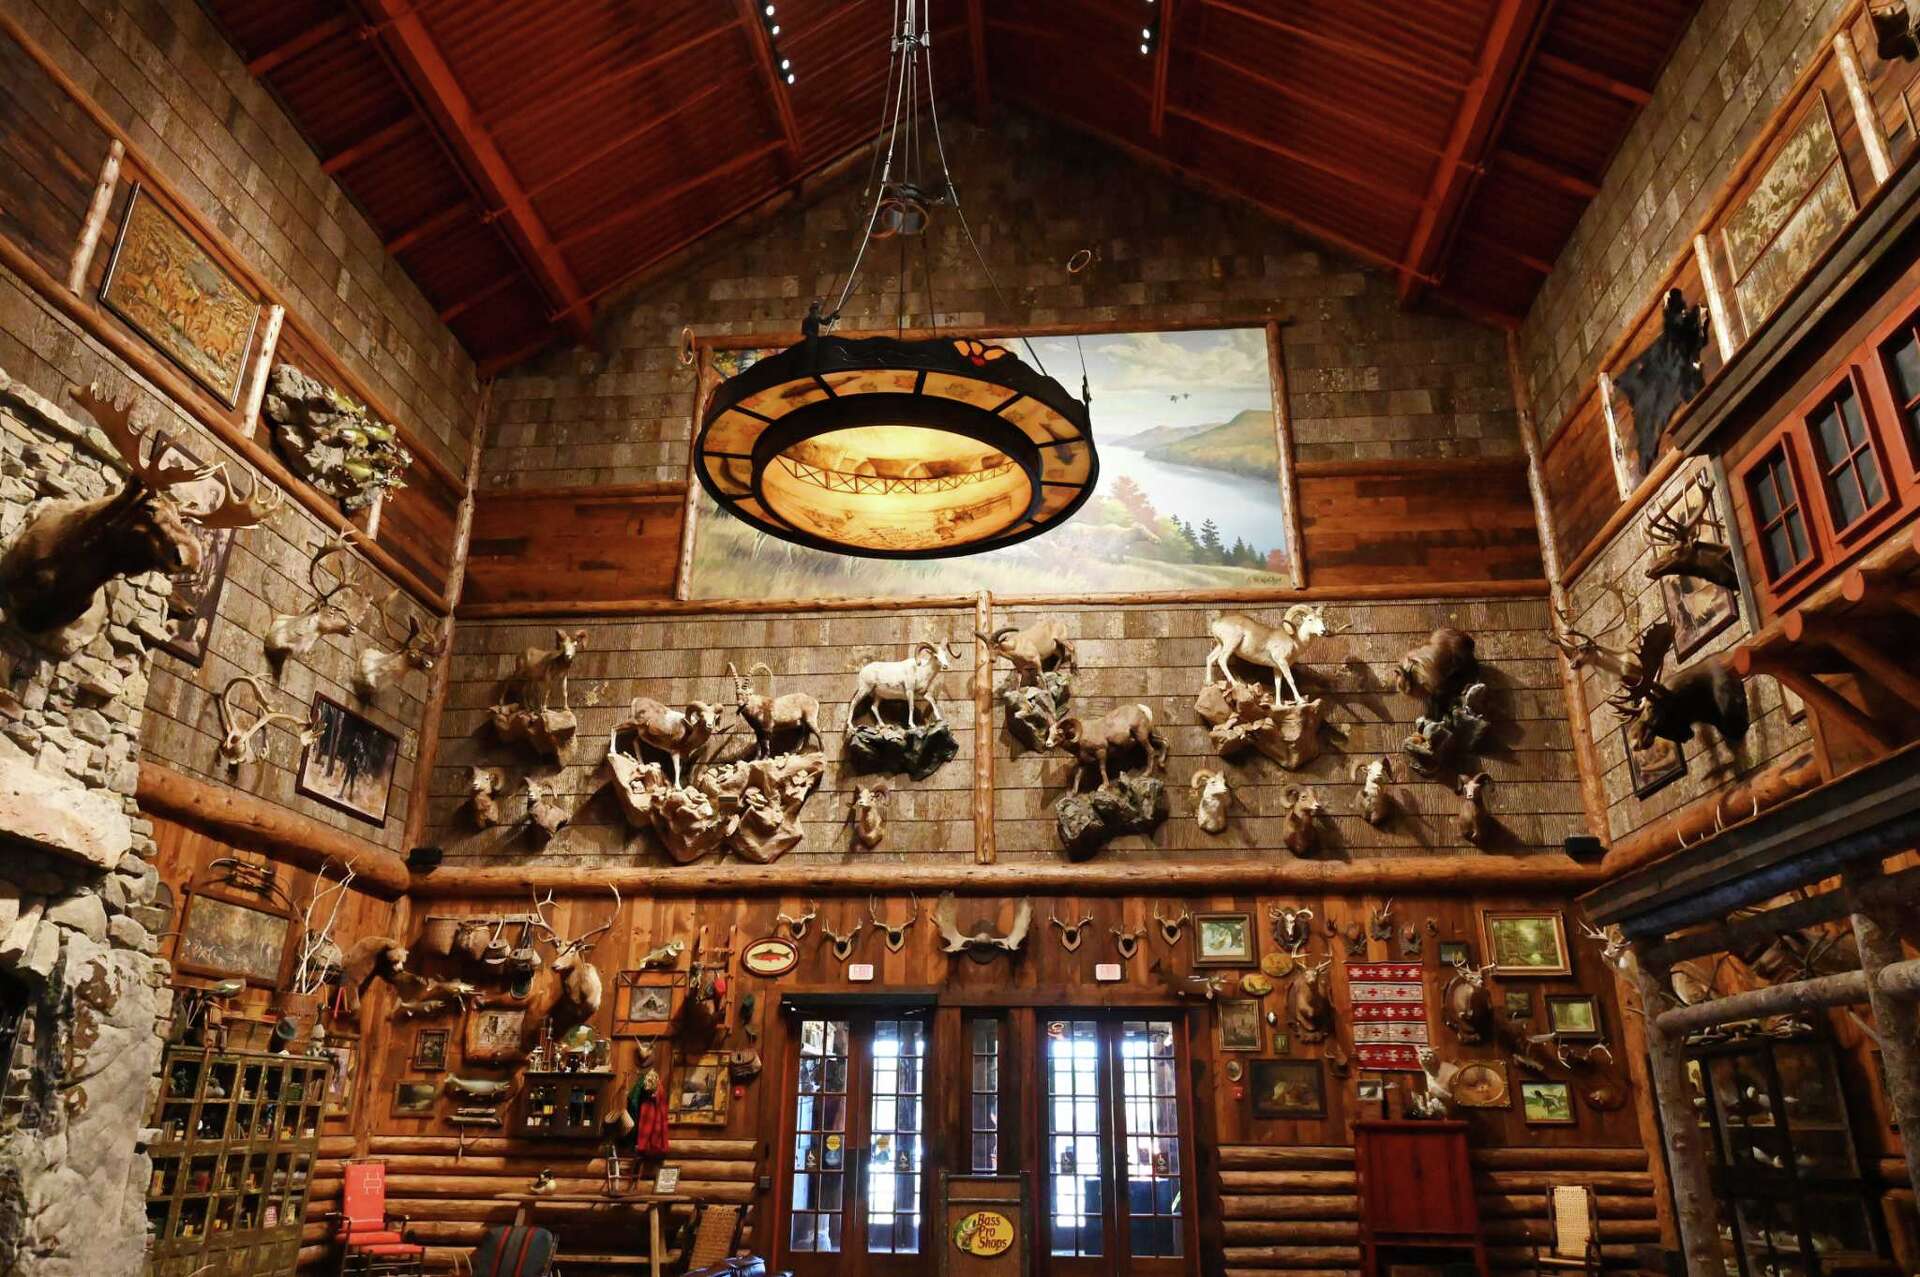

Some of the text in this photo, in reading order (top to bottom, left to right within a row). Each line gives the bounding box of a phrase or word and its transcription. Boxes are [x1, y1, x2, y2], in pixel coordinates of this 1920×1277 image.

[977, 1213, 1000, 1226] Bass
[978, 1225, 995, 1238] Pro
[977, 1236, 1007, 1251] Shops
